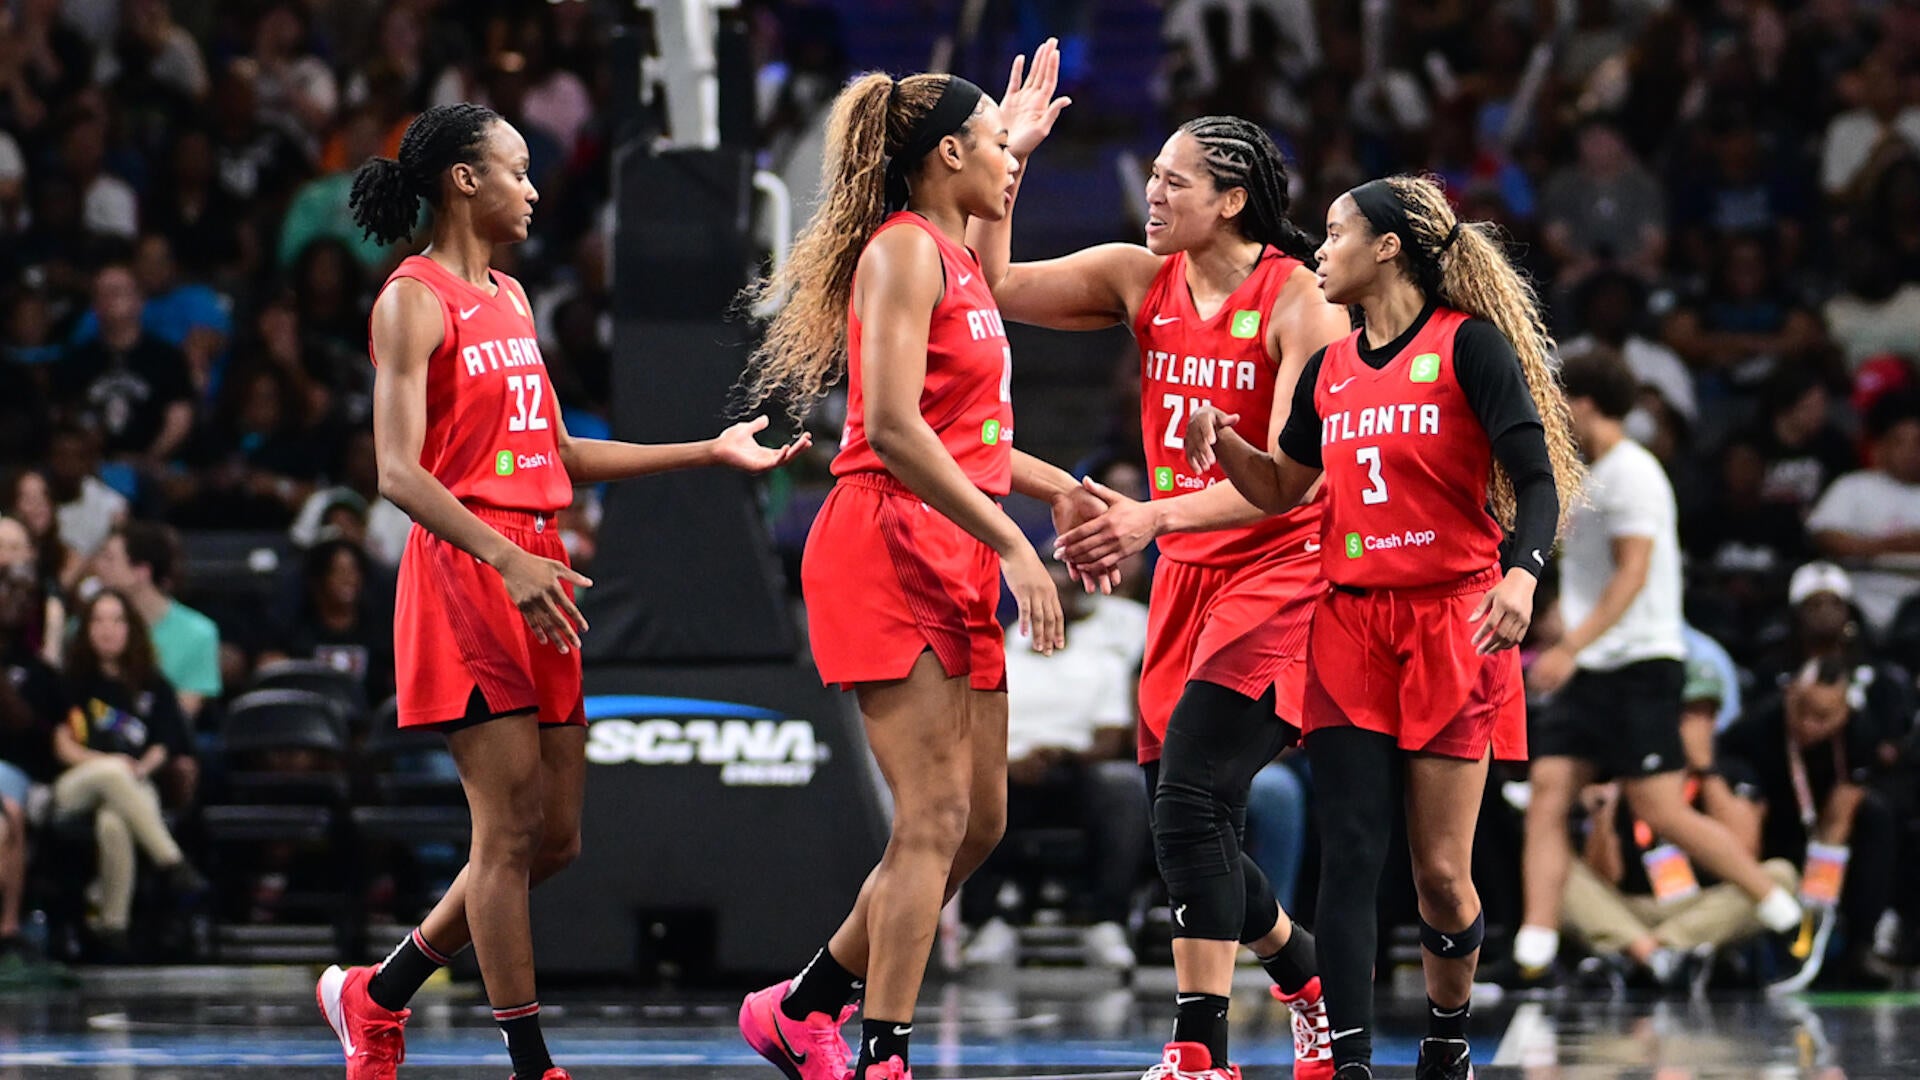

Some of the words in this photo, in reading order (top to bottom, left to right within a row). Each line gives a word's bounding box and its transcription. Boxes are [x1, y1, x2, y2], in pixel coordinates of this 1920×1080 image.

[507, 374, 548, 432] 32
[517, 453, 547, 469] Cash
[1356, 446, 1389, 505] 3
[1364, 533, 1402, 550] Cash
[1404, 530, 1436, 546] App
[586, 719, 817, 764] SCANA
